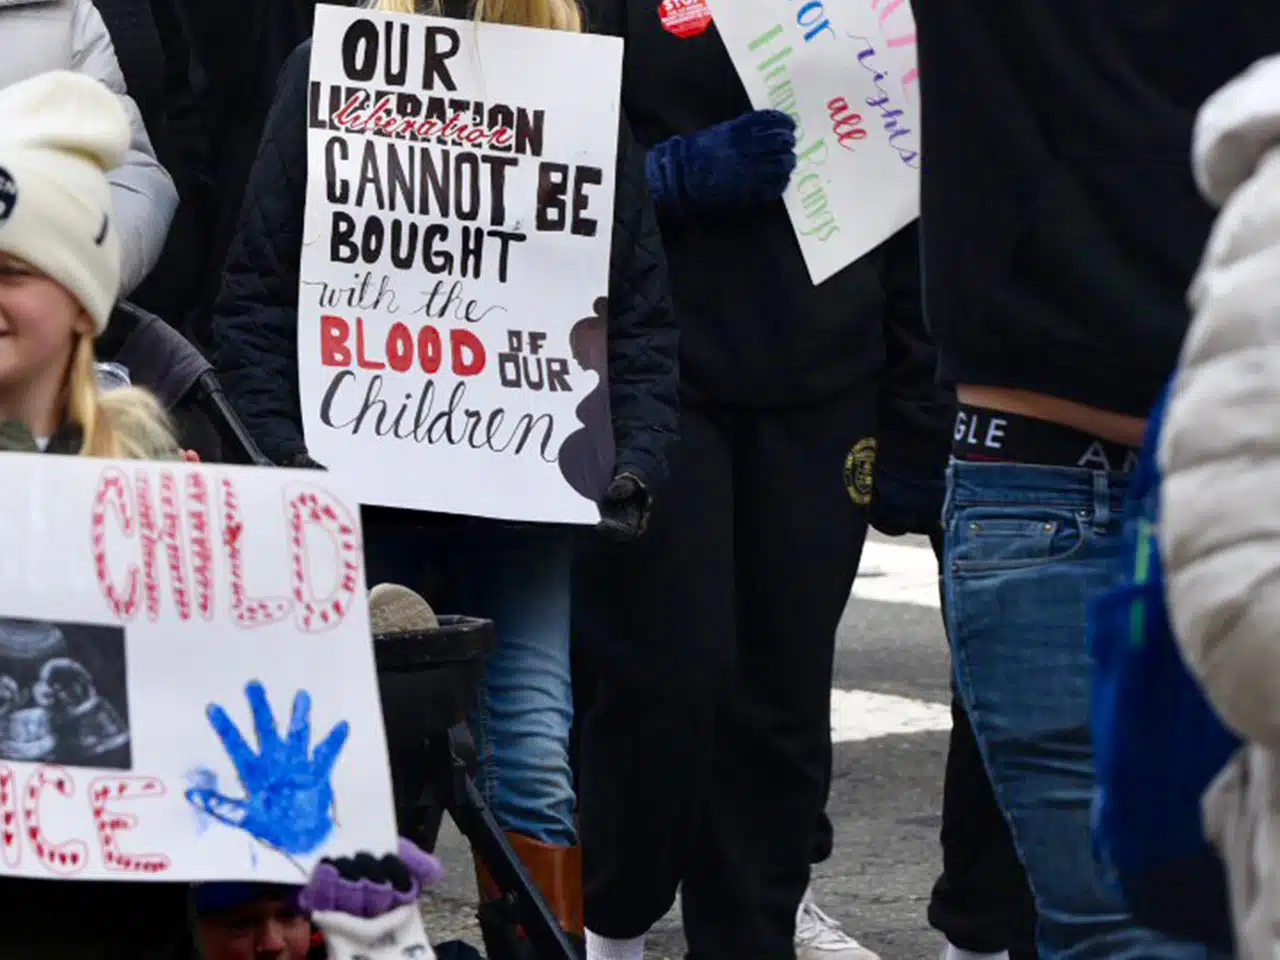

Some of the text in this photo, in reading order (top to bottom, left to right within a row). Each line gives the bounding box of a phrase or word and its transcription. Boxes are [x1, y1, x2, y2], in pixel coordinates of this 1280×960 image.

[341, 18, 461, 92] OUR
[747, 23, 807, 141] Hum
[826, 96, 868, 153] all
[324, 135, 603, 237] CANNOT BE
[329, 210, 527, 283] BOUGHT
[303, 272, 508, 324] with the
[320, 315, 548, 377] BLOOD OF
[497, 351, 574, 392] OUR
[319, 369, 559, 464] Children
[90, 466, 362, 632] CHILD
